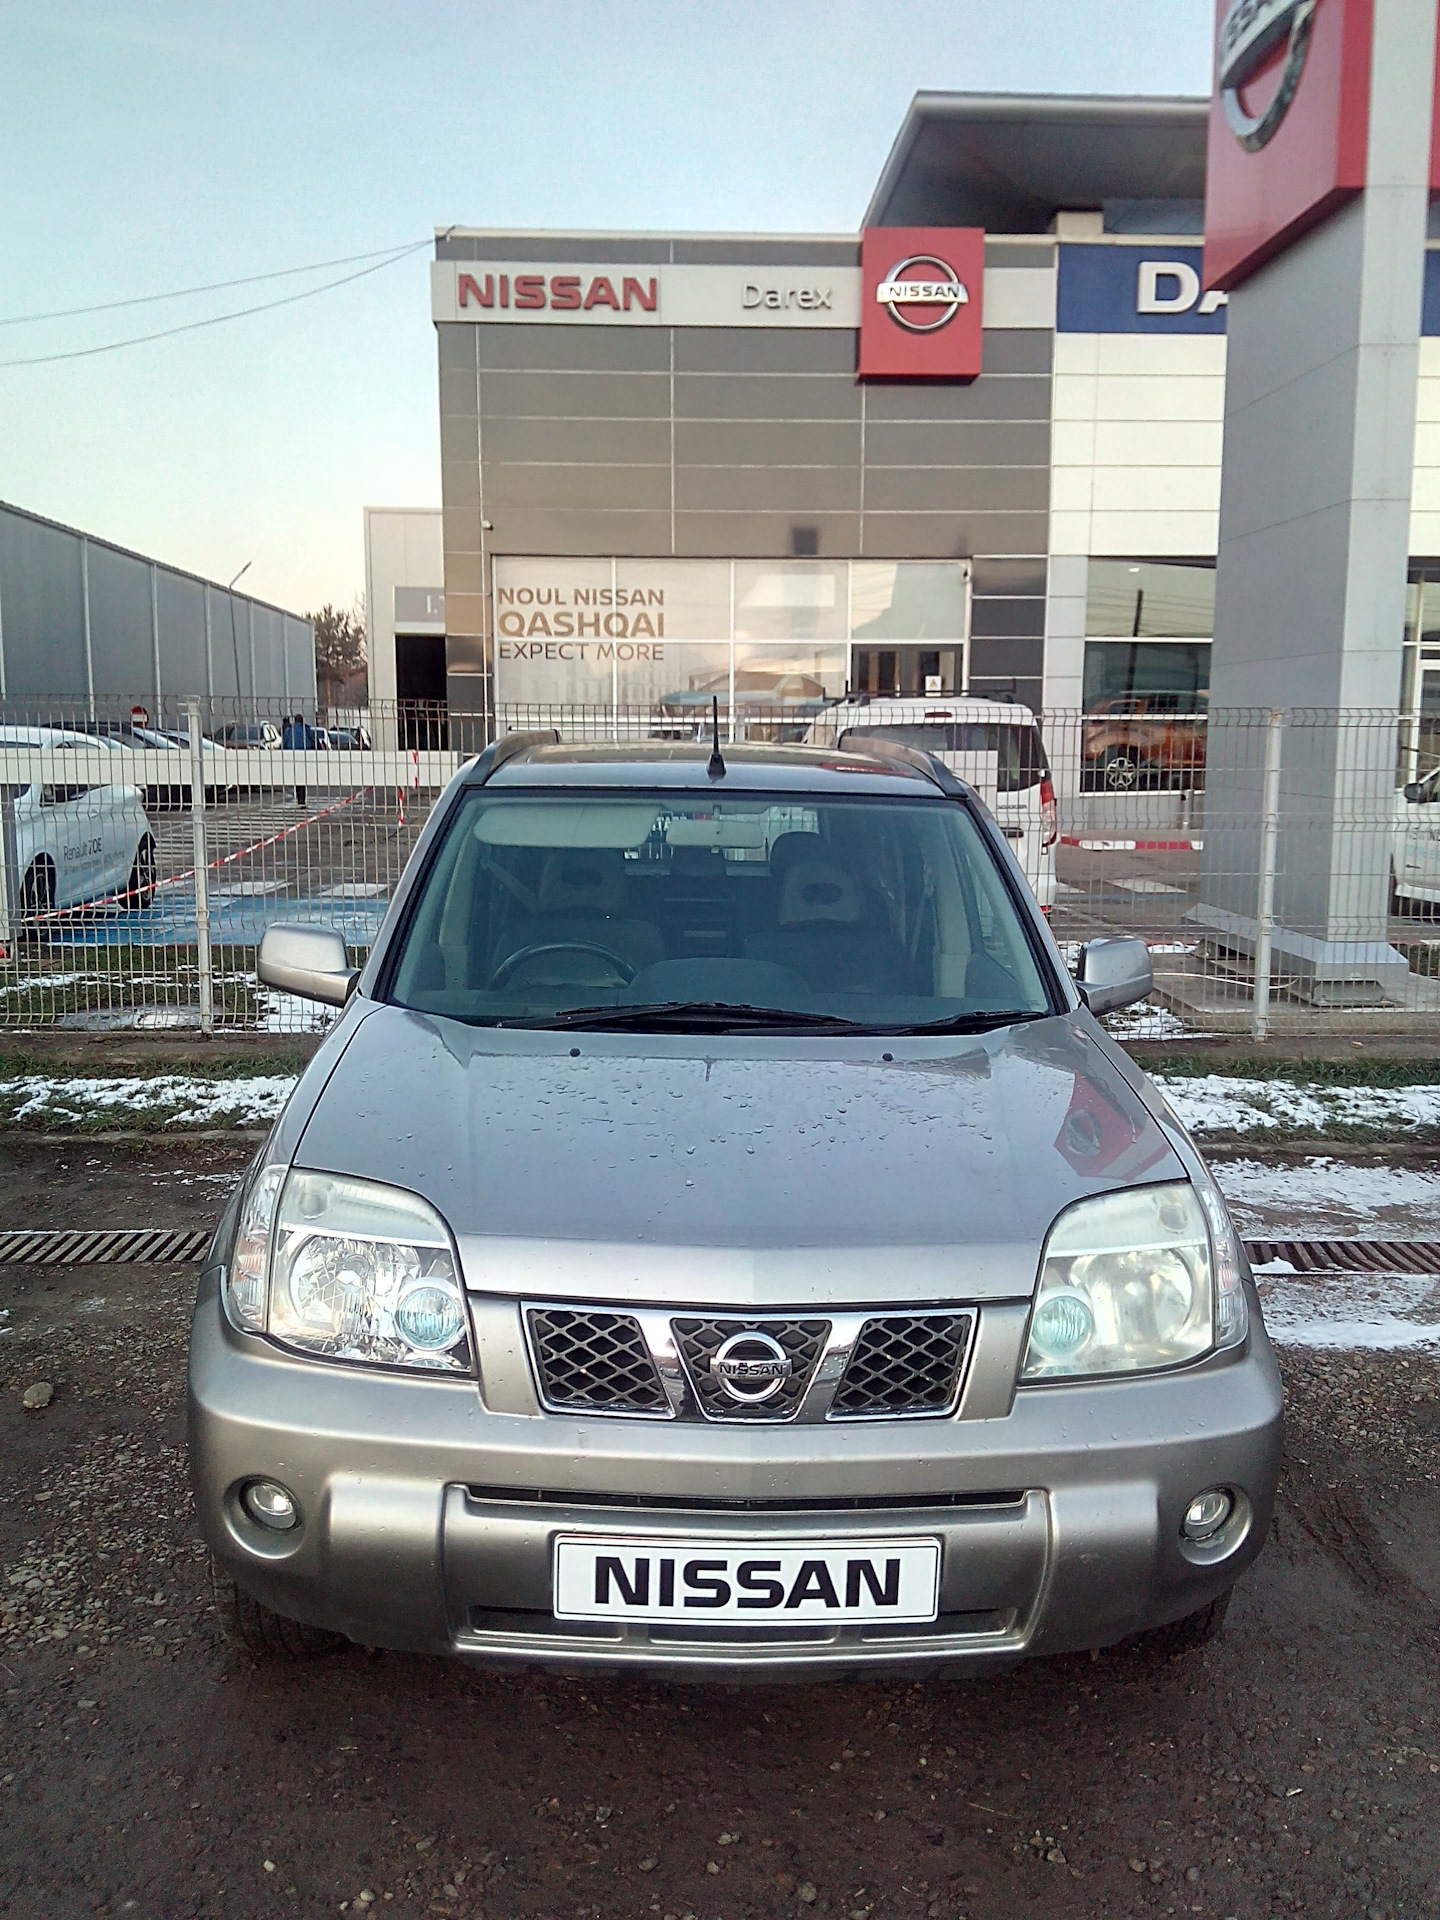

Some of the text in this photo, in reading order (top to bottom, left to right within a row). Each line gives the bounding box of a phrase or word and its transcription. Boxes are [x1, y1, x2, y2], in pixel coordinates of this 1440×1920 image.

[457, 272, 659, 312] NISSAN
[742, 282, 832, 311] Darex
[889, 285, 960, 298] NISSAN
[498, 587, 664, 607] NOUL NISSAN
[499, 610, 664, 638] QASHQAI
[499, 642, 665, 661] EXPECT MORE
[719, 1362, 784, 1375] NISSAN
[594, 1556, 901, 1609] NISSAN
